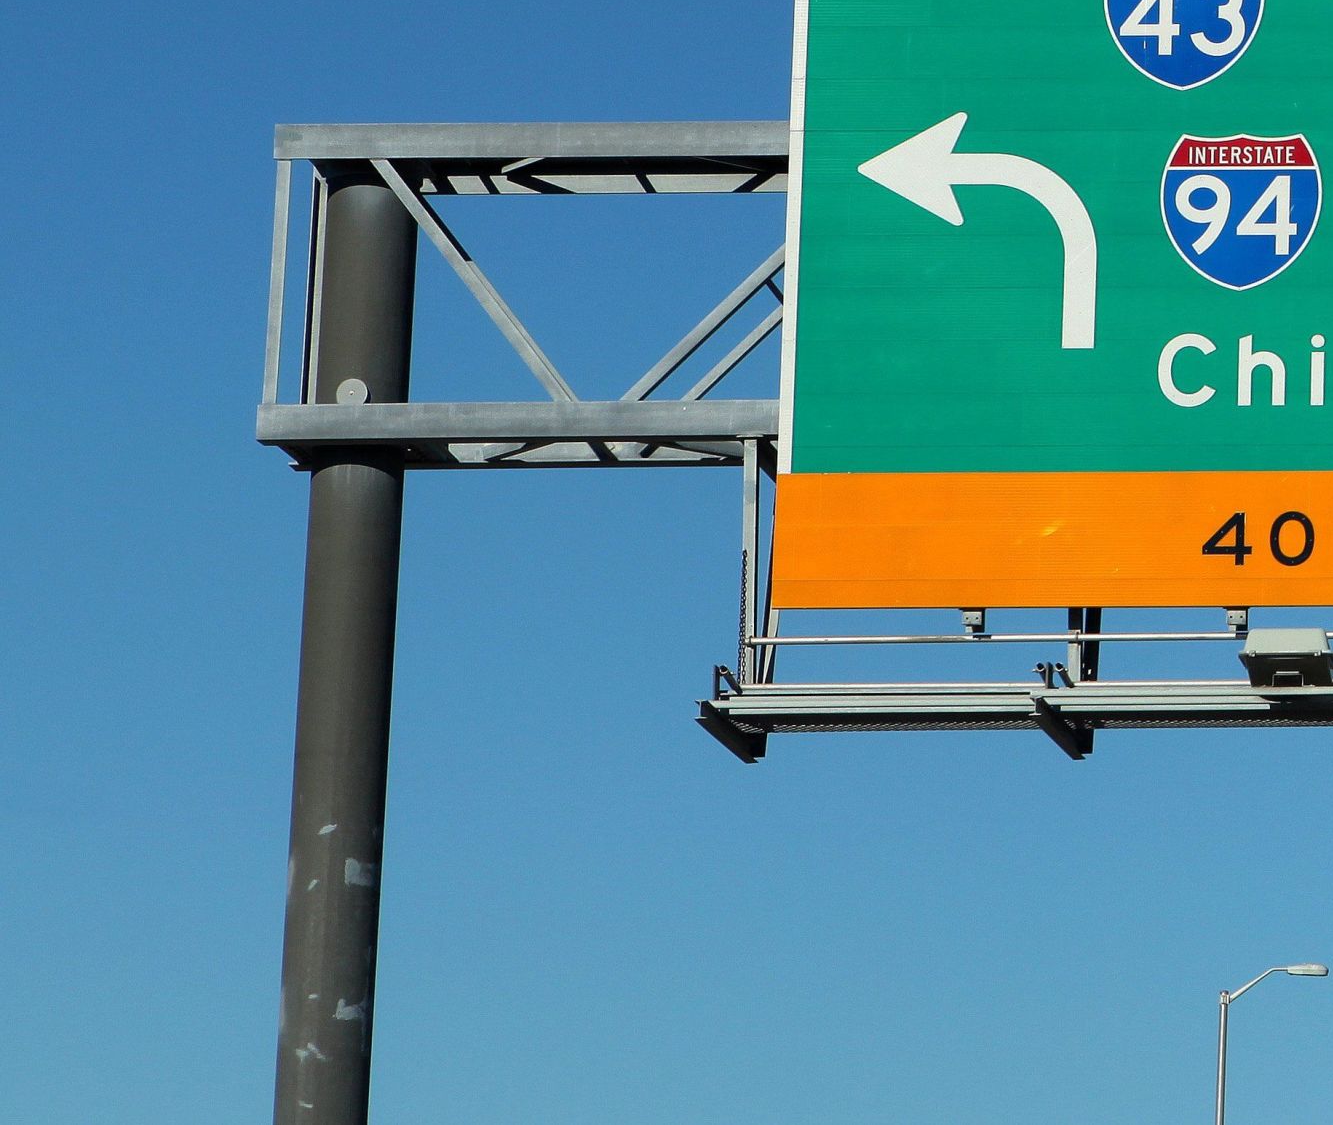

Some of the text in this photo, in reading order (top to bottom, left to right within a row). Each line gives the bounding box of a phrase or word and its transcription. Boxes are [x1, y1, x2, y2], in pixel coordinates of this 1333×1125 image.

[1187, 145, 1296, 166] INTERSTATE
[1173, 174, 1299, 256] 94
[1201, 510, 1315, 567] 40
